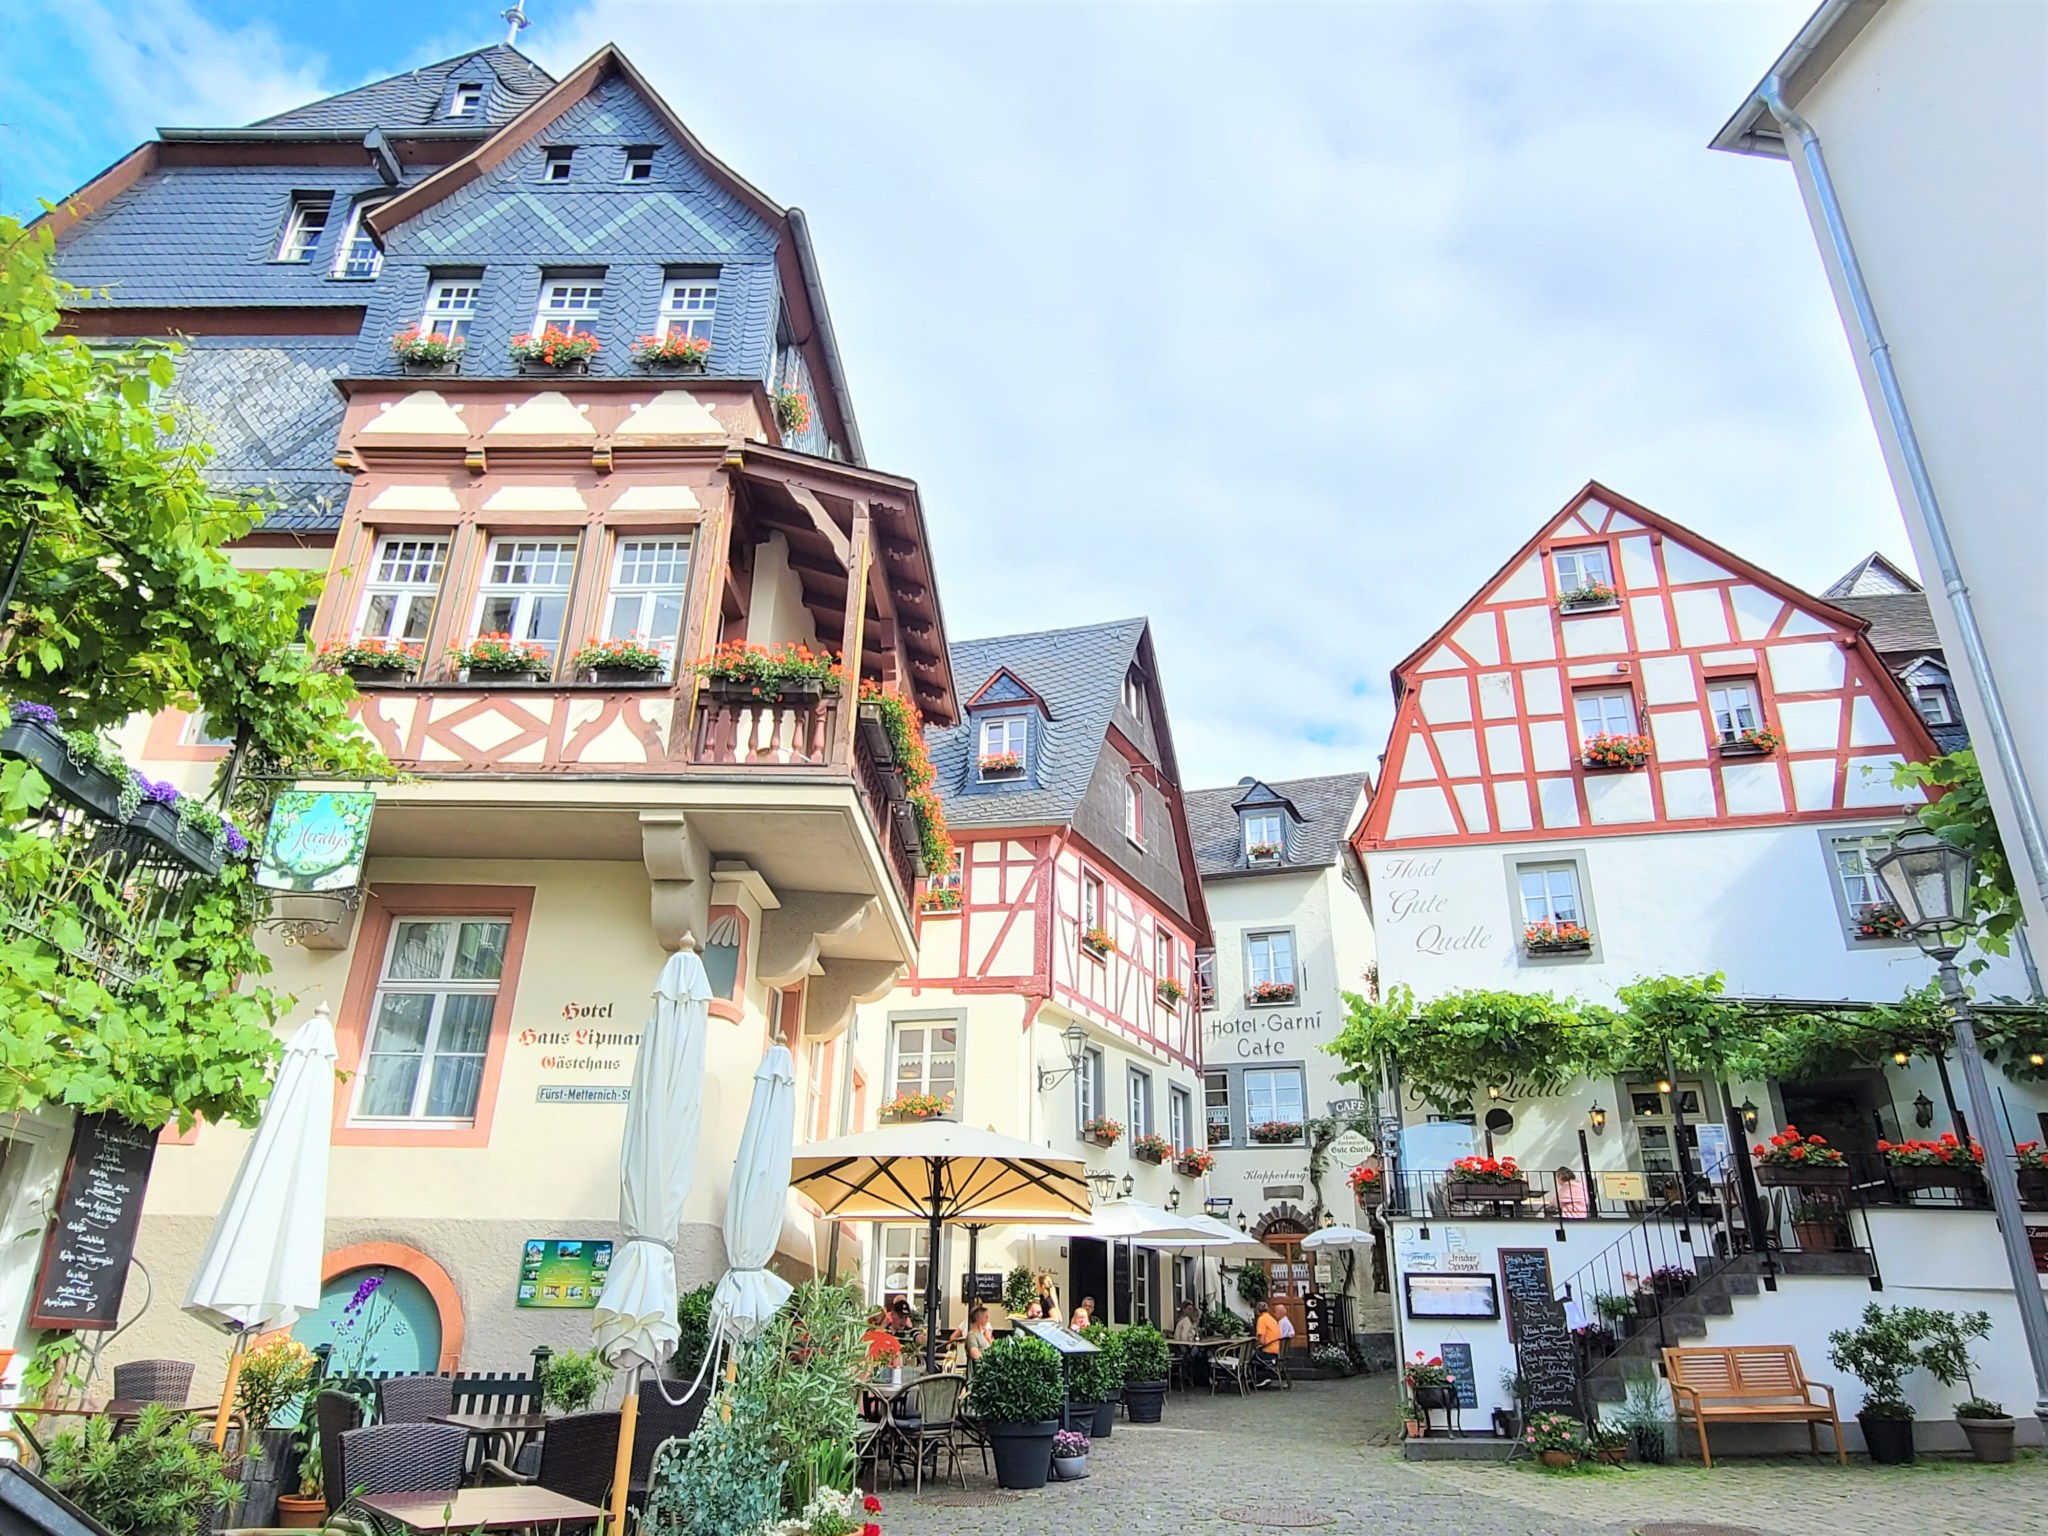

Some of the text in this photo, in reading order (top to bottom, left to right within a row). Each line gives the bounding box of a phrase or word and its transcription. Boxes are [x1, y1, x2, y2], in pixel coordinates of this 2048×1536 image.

[1382, 857, 1442, 879] Hotel
[1387, 889, 1448, 923] Gute
[1416, 925, 1492, 955] Quelle
[561, 1002, 613, 1021] Hotel
[1211, 1018, 1256, 1036] Hotel
[518, 1028, 570, 1046] Haus
[541, 1056, 620, 1072] Gästehaus
[1335, 1100, 1365, 1113] CAFE
[1331, 1145, 1373, 1154] Gute Quelle
